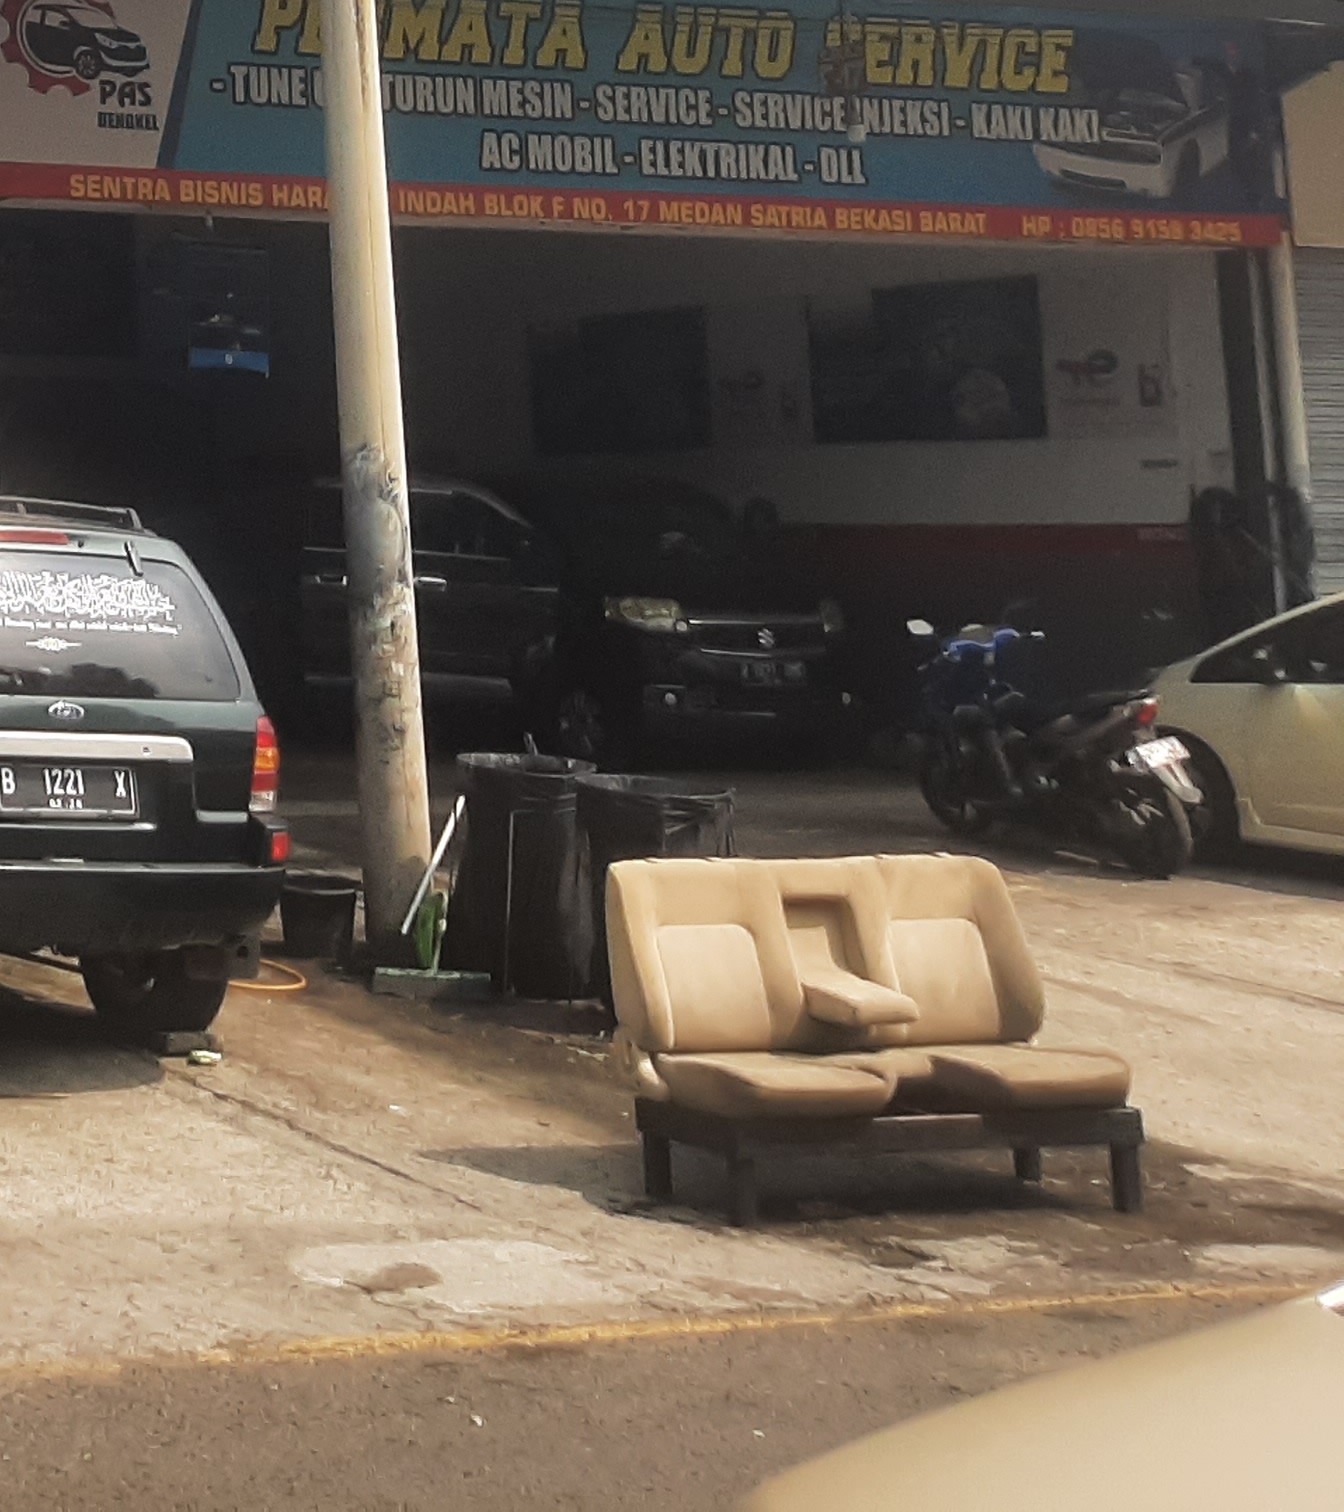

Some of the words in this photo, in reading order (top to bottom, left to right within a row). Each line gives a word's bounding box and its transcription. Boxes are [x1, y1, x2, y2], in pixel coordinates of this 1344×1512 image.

[617, 2, 797, 80] AUTO
[98, 79, 152, 108] PAS
[229, 64, 308, 107] TUNE
[381, 73, 476, 116] TURUN
[481, 78, 573, 120] MESIN
[595, 84, 713, 126] SERVICE
[733, 91, 846, 133] SERVICE
[970, 101, 1034, 141] KAKI
[1038, 106, 1101, 144] KAKI
[480, 130, 522, 172] AC
[525, 133, 620, 176] MOBIL
[639, 139, 800, 183] ELEKTRIKAL
[818, 147, 867, 186] DLL
[69, 174, 171, 201] SENTRA
[179, 179, 265, 206] BISNIS
[398, 189, 476, 216] INDAH
[483, 193, 545, 218] BLOK
[551, 197, 566, 219] F
[572, 197, 613, 222] NO.
[623, 199, 652, 221] 17
[658, 200, 743, 226] MEDAN
[750, 204, 828, 230] SATRIA
[835, 207, 913, 233] BEKASI
[920, 210, 988, 235] BARAT
[1021, 214, 1053, 237] HP
[1, 767, 16, 795] B
[42, 767, 85, 796] 1221
[114, 769, 127, 798] X
